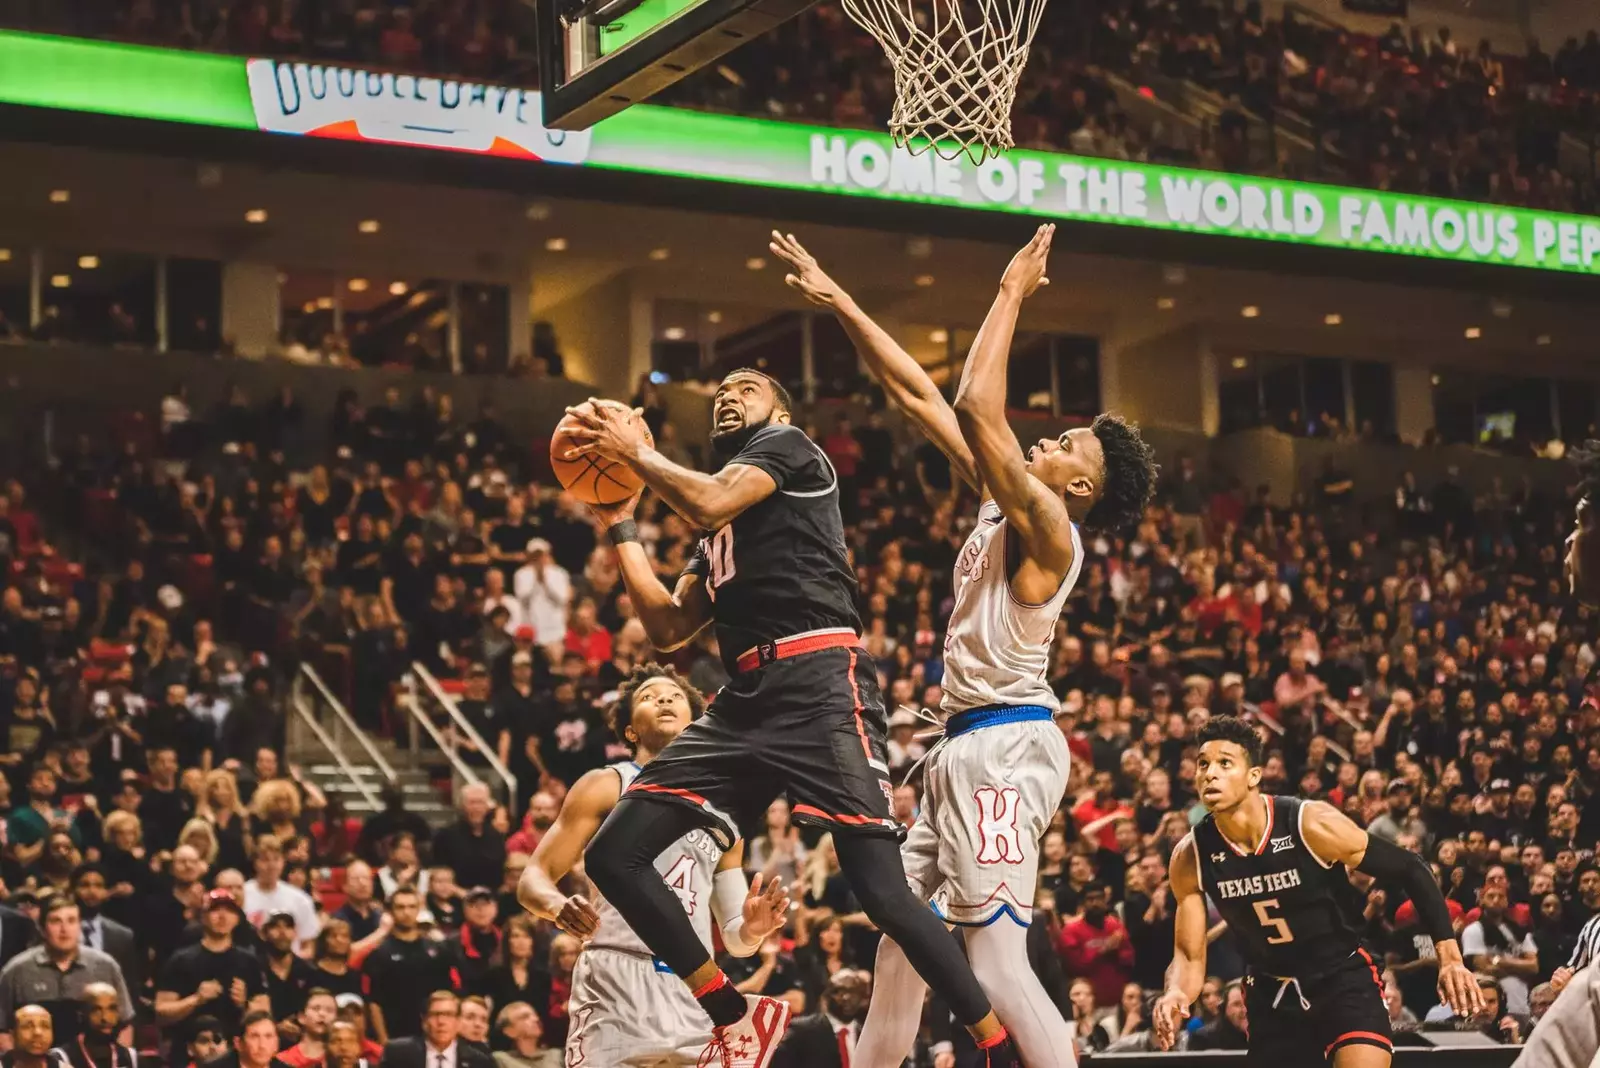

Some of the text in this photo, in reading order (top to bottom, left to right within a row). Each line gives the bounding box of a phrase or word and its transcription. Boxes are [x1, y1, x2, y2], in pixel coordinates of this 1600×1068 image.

[810, 134, 964, 197] HOME
[976, 157, 1045, 206] OF
[1060, 163, 1148, 218] THE
[1160, 174, 1324, 236] WORLD
[1340, 196, 1520, 259] FAMOUS
[664, 854, 698, 916] 4
[1217, 868, 1302, 899] TEXAS TECH
[1252, 898, 1294, 944] 5
